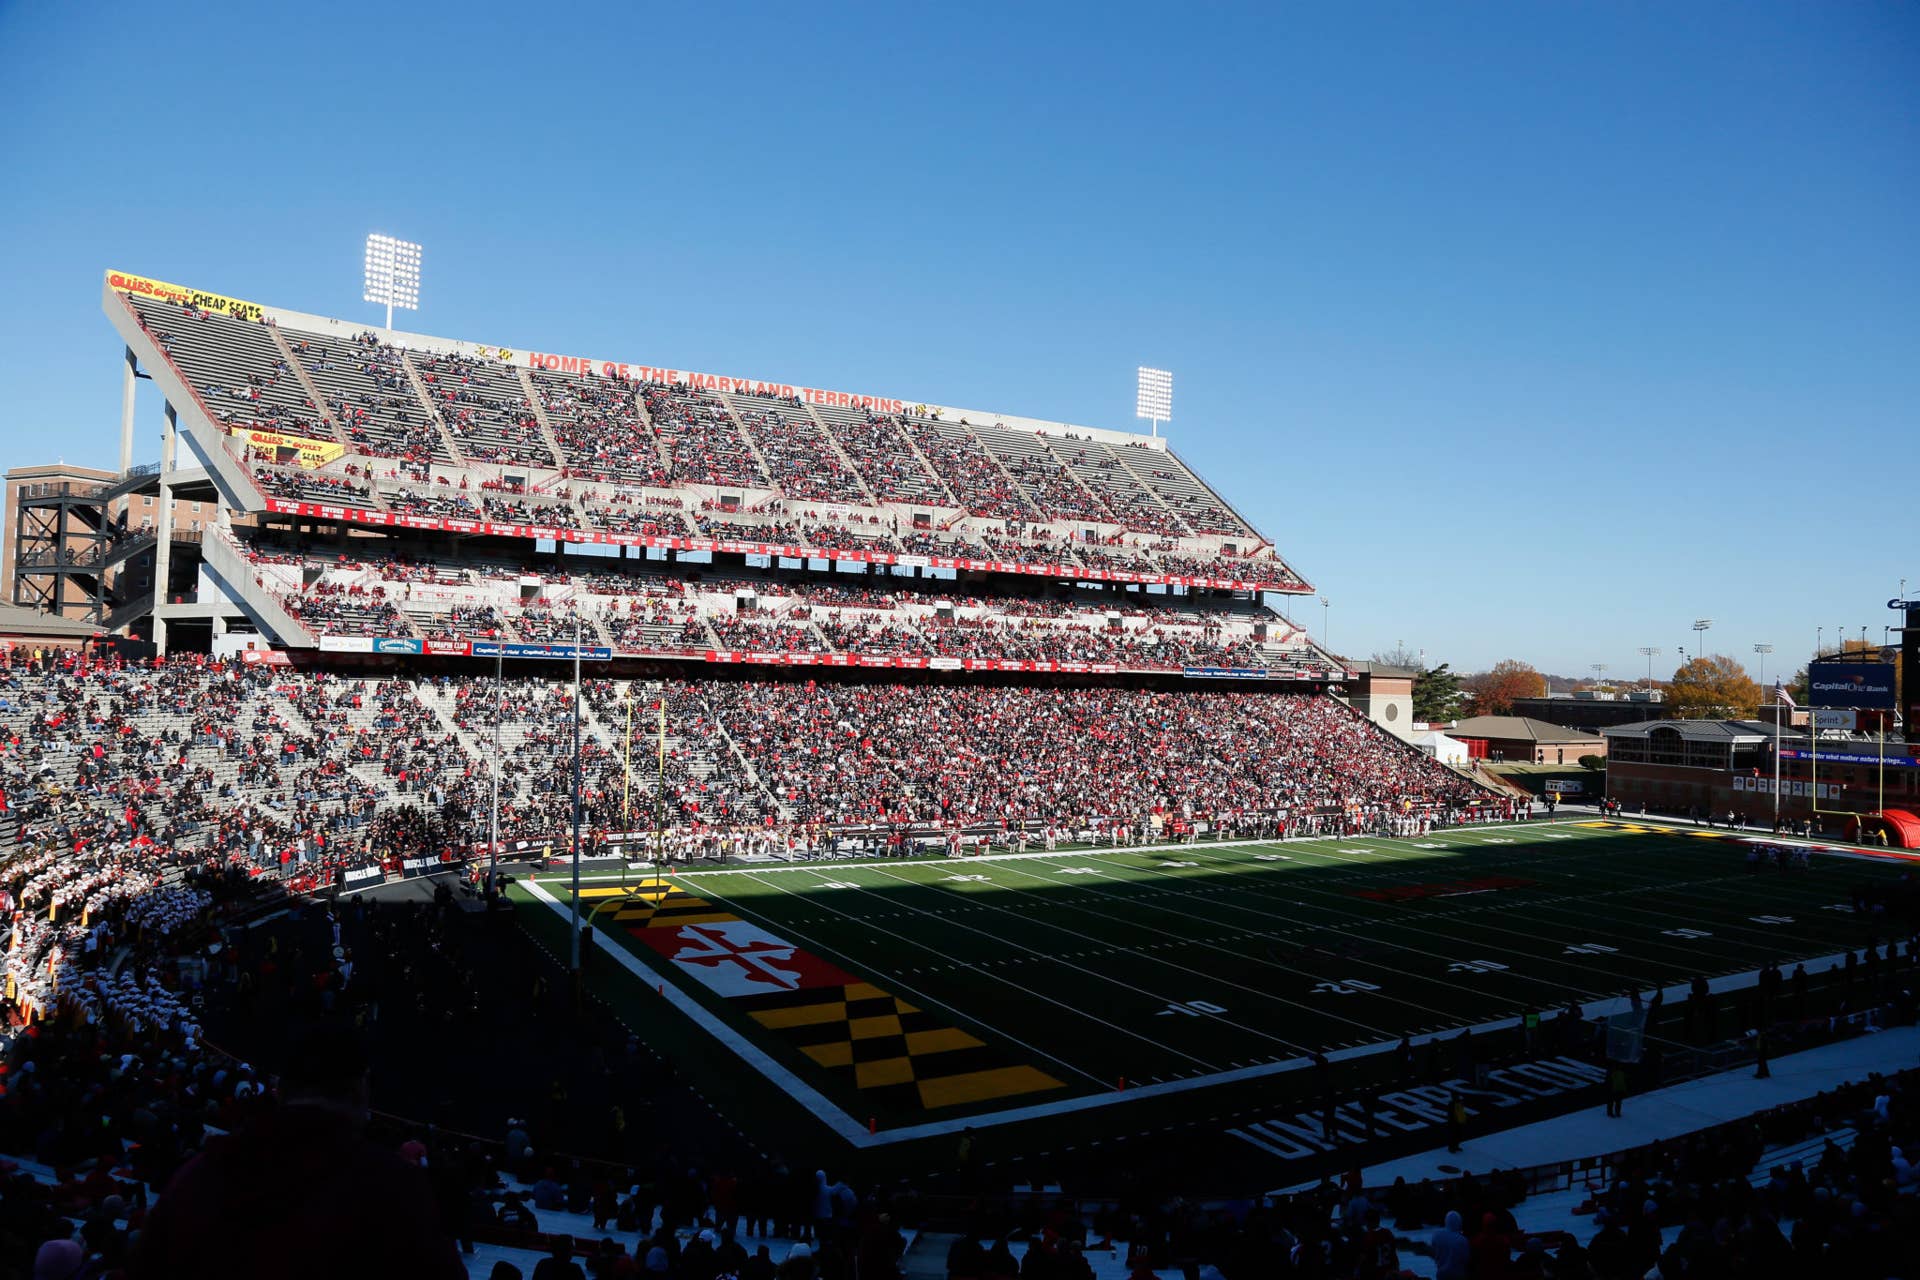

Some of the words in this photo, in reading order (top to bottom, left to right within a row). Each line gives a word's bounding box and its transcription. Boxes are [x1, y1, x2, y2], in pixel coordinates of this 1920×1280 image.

[192, 293, 226, 310] CHEAP
[229, 301, 262, 318] SEATS
[529, 352, 591, 374] HOME
[602, 361, 629, 377] OF
[639, 366, 678, 385] THE
[689, 373, 794, 398] MARYLAND
[803, 388, 903, 413] TERRAPINS
[1866, 684, 1888, 692] Bank
[1816, 716, 1839, 725] Sprint
[1449, 959, 1510, 974] 30
[1315, 978, 1382, 994] 20
[1167, 1000, 1228, 1016] 10
